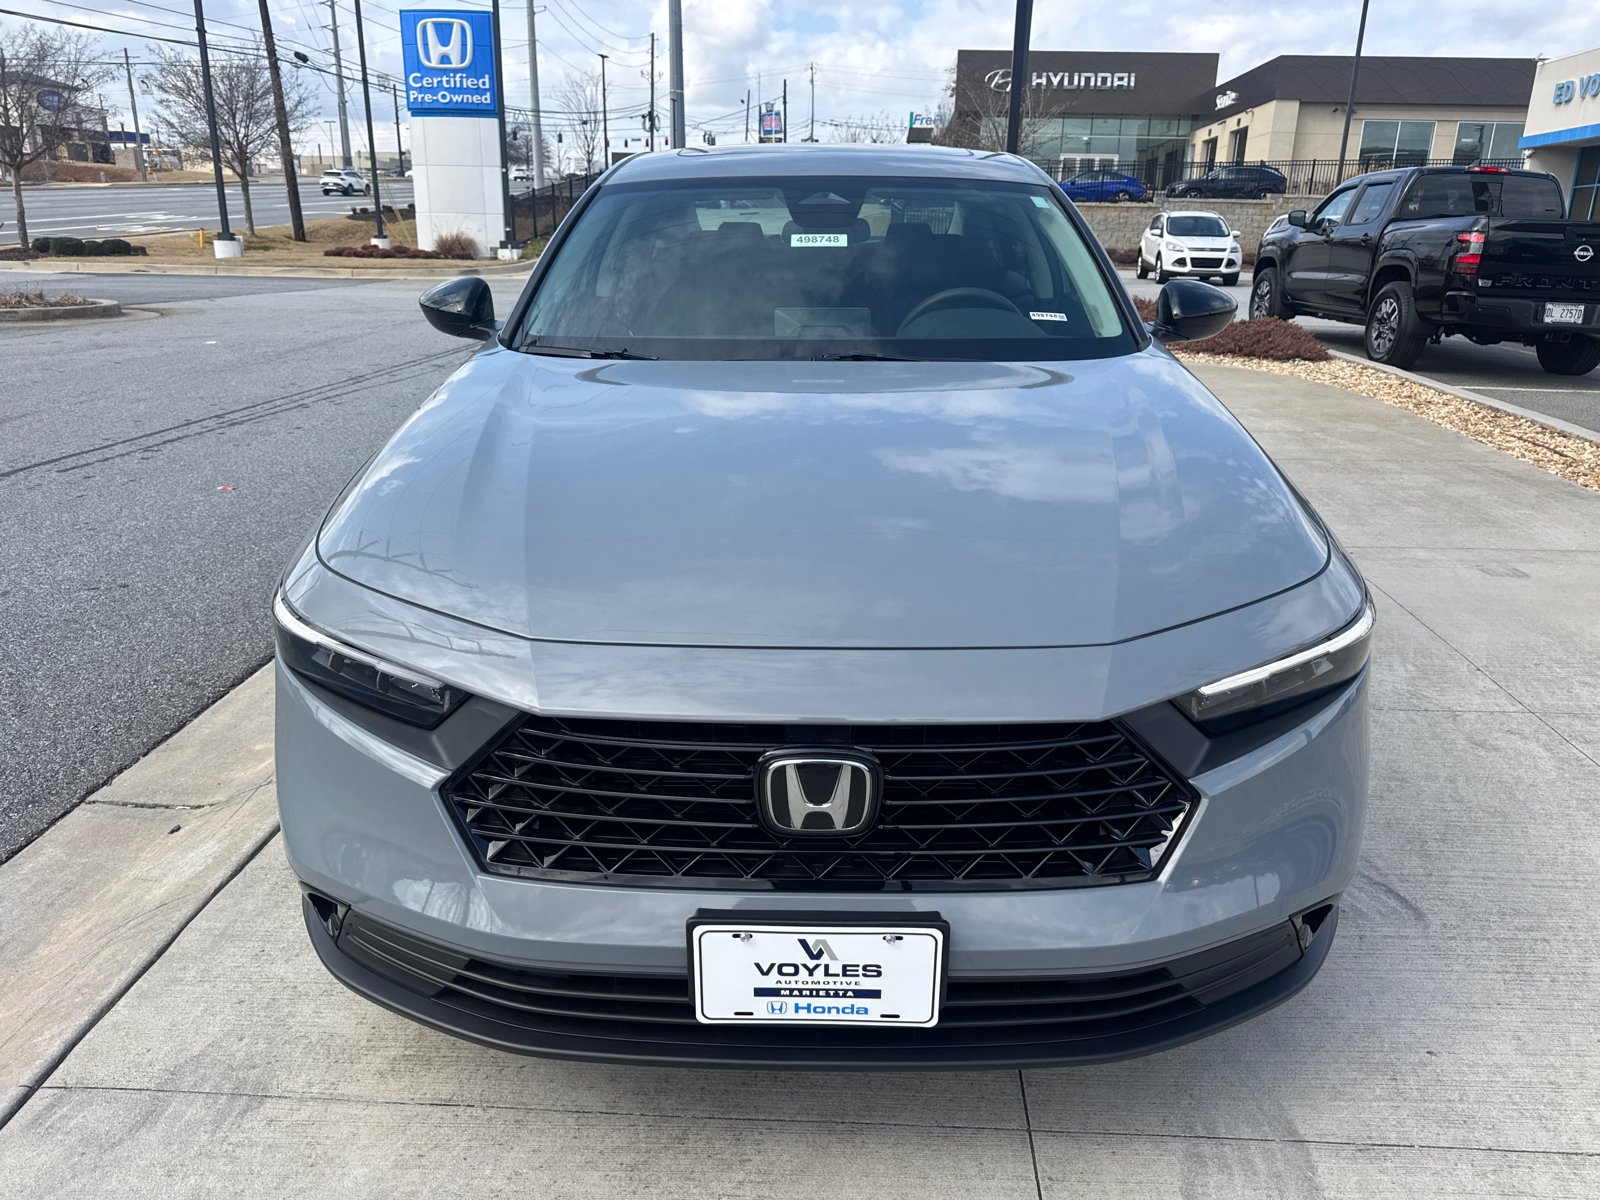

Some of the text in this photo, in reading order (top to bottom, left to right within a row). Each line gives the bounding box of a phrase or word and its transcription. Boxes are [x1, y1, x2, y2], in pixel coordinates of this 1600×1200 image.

[408, 72, 490, 89] Certified
[1031, 72, 1136, 90] HYUNDAI
[409, 90, 491, 104] Pre-Owned
[1552, 80, 1575, 104] ED
[796, 235, 840, 244] 498748
[753, 962, 883, 978] VOYLES
[780, 989, 855, 997] MARIETTA
[794, 1003, 869, 1015] Honda
